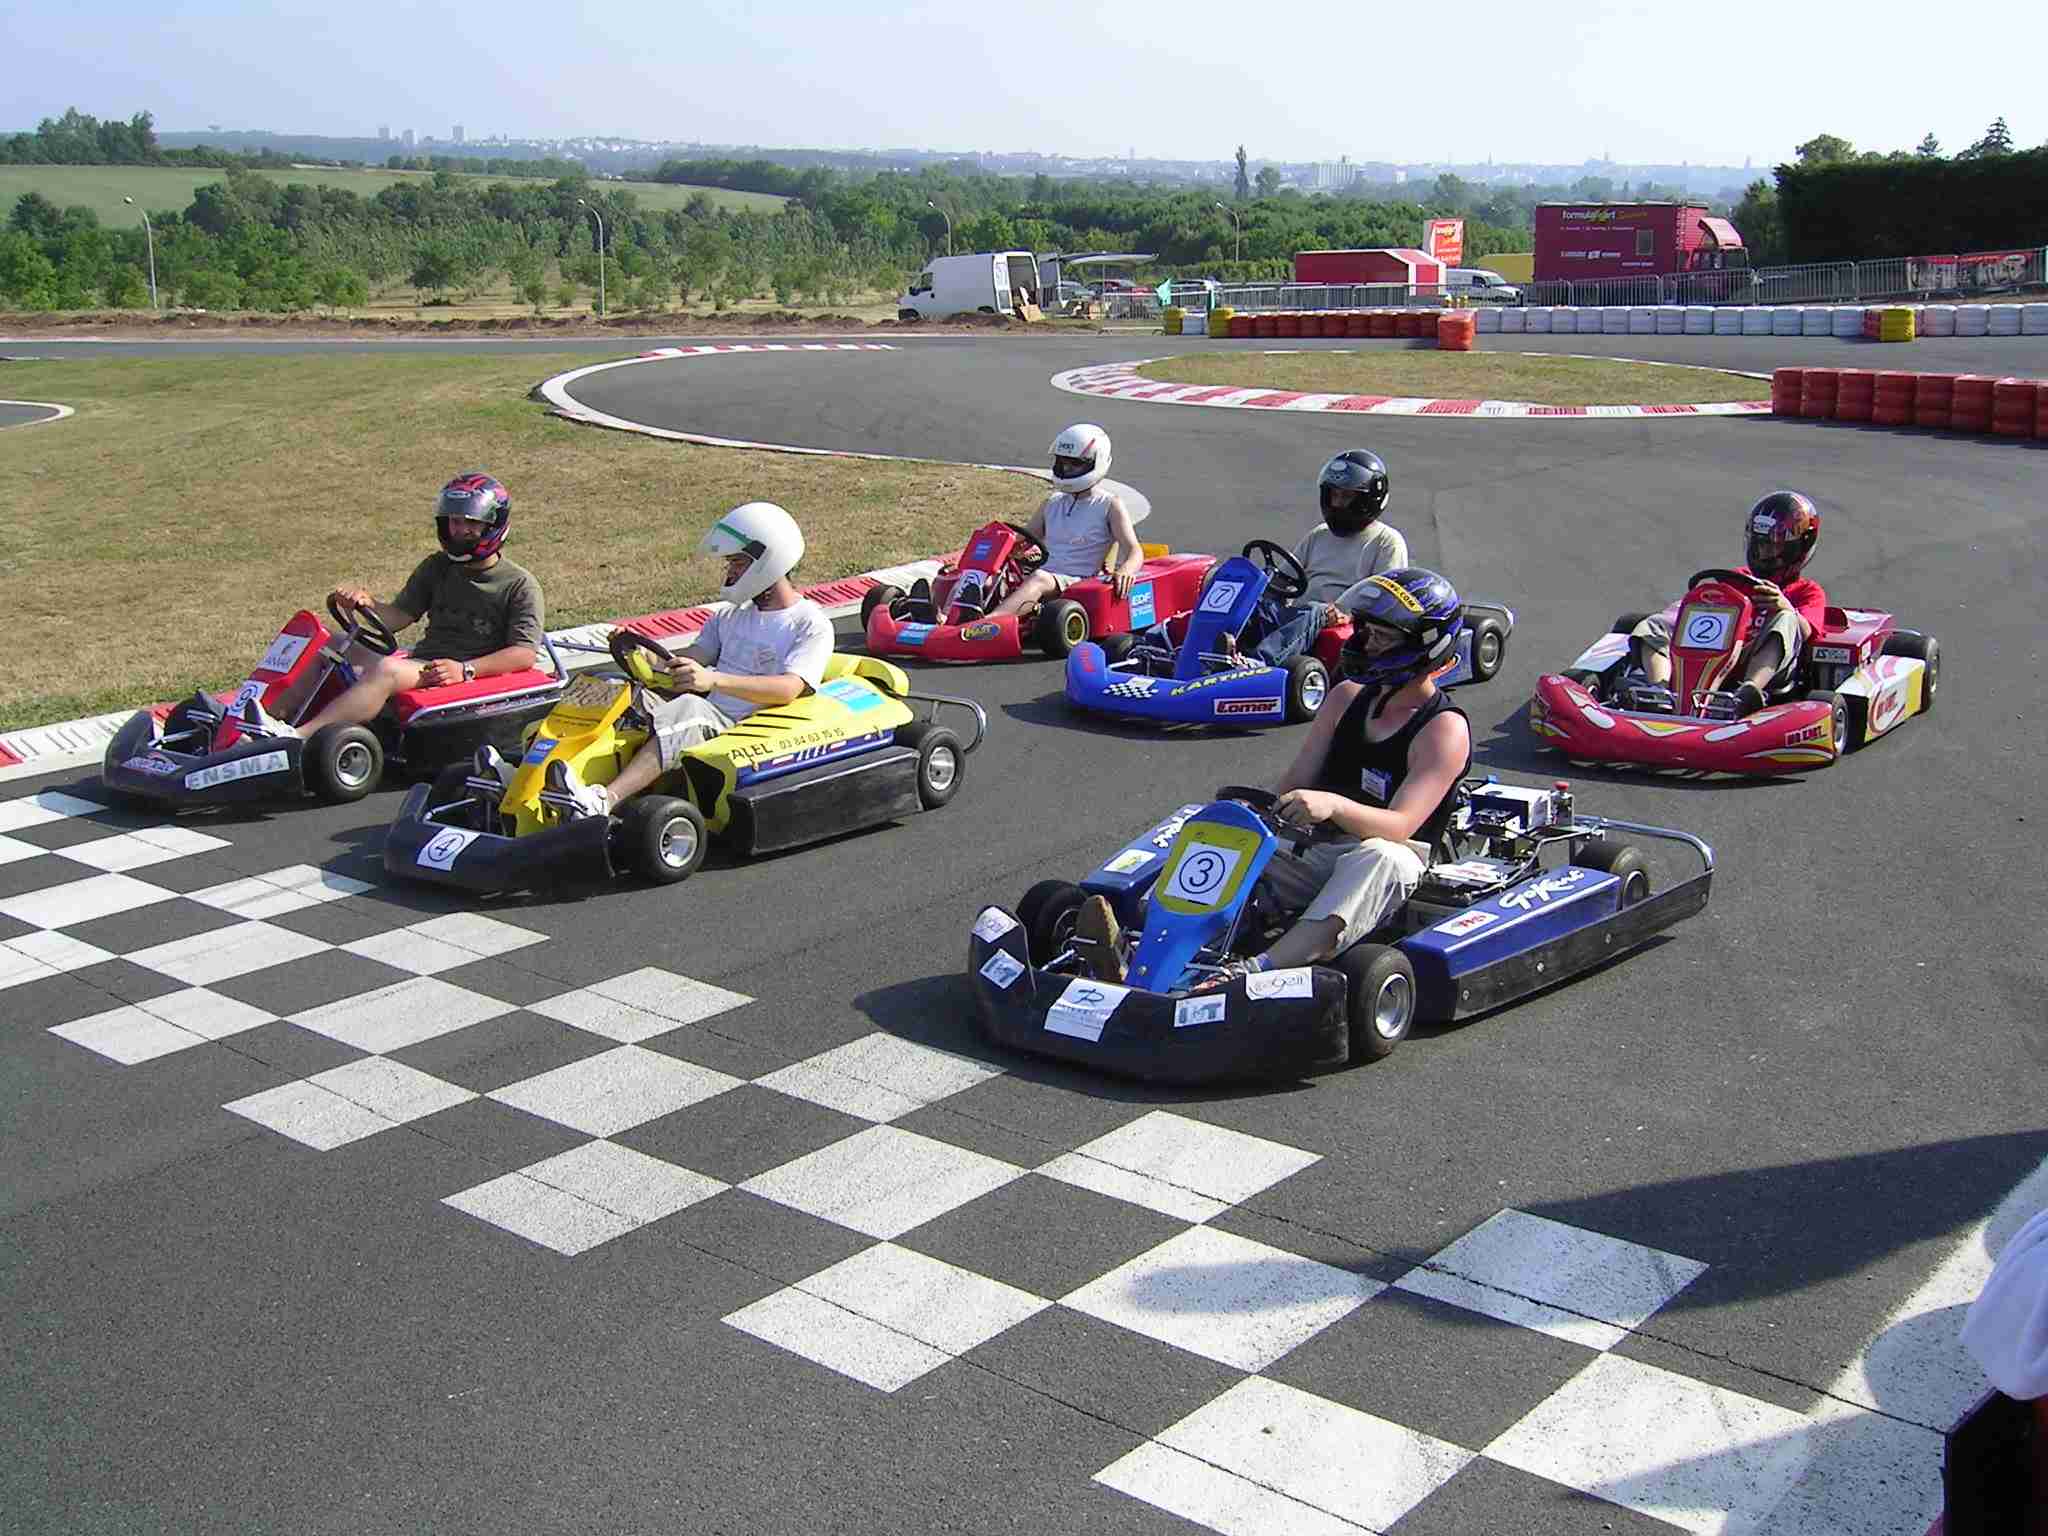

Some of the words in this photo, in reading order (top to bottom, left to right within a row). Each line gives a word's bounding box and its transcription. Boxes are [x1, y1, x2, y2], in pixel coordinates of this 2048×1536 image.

[1170, 666, 1273, 696] KARTING
[187, 754, 284, 788] ENSMA
[1188, 858, 1214, 888] 3
